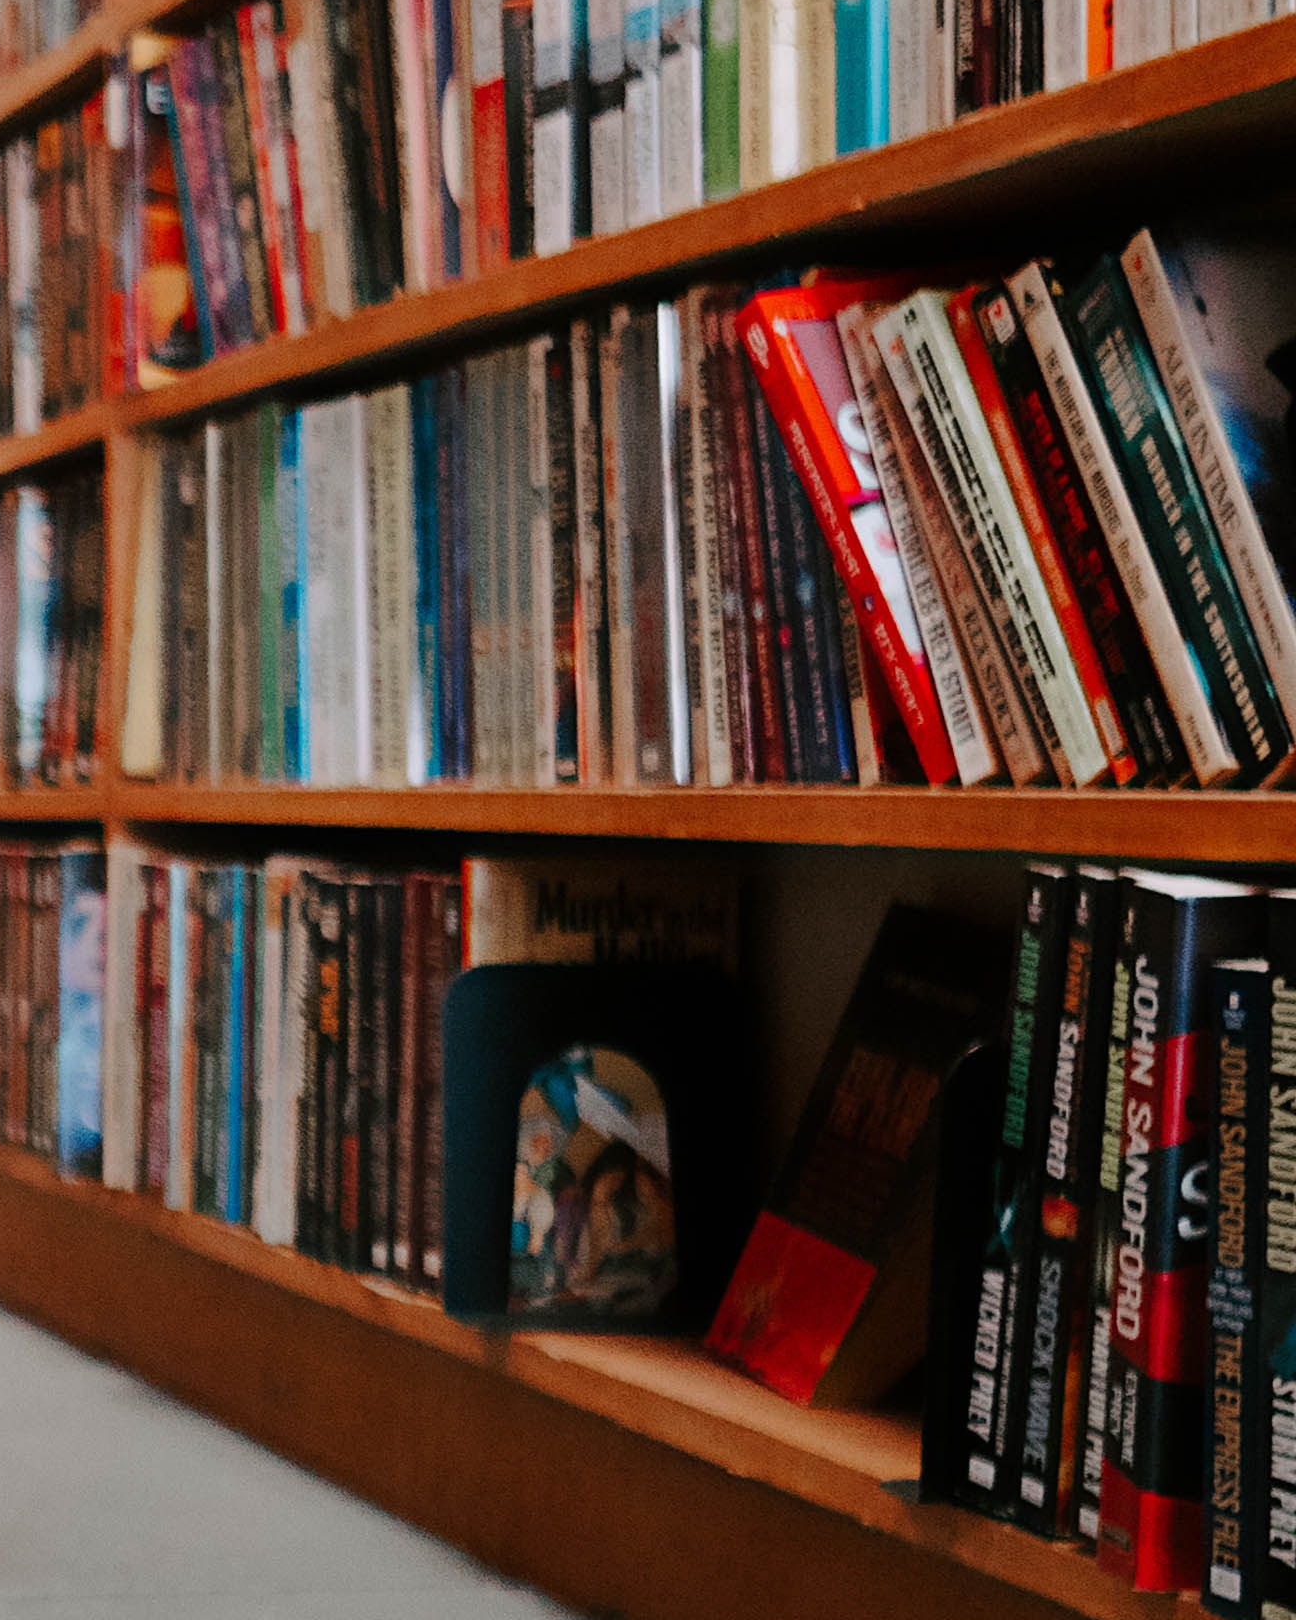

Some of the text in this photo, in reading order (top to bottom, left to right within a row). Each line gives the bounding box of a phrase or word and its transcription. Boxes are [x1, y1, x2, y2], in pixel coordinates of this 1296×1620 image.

[1199, 453, 1242, 532] TIME
[1181, 555, 1214, 604] THE
[1200, 602, 1273, 763] SMITHSONIAN
[1002, 930, 1041, 1149] JOHN SANDFORD
[1046, 937, 1092, 1181] JOHN SANDFORD
[1098, 960, 1131, 1193] JOHN SANDFORD
[1266, 977, 1296, 1273] JOHN SANDFORD
[1115, 954, 1159, 1341] JOHN SANDFORD
[1216, 1037, 1247, 1270] JOHN SANDFORD
[967, 1268, 1006, 1444] WICKED PREY
[1023, 1257, 1061, 1472] SHOCK WAVE
[1082, 1307, 1112, 1497] PHANTOM PREY
[1108, 1383, 1124, 1441] PREY
[1119, 1370, 1139, 1467] EXTREME
[1211, 1336, 1240, 1571] THE EMPRESS FILE
[1268, 1376, 1296, 1570] STORM PREY
